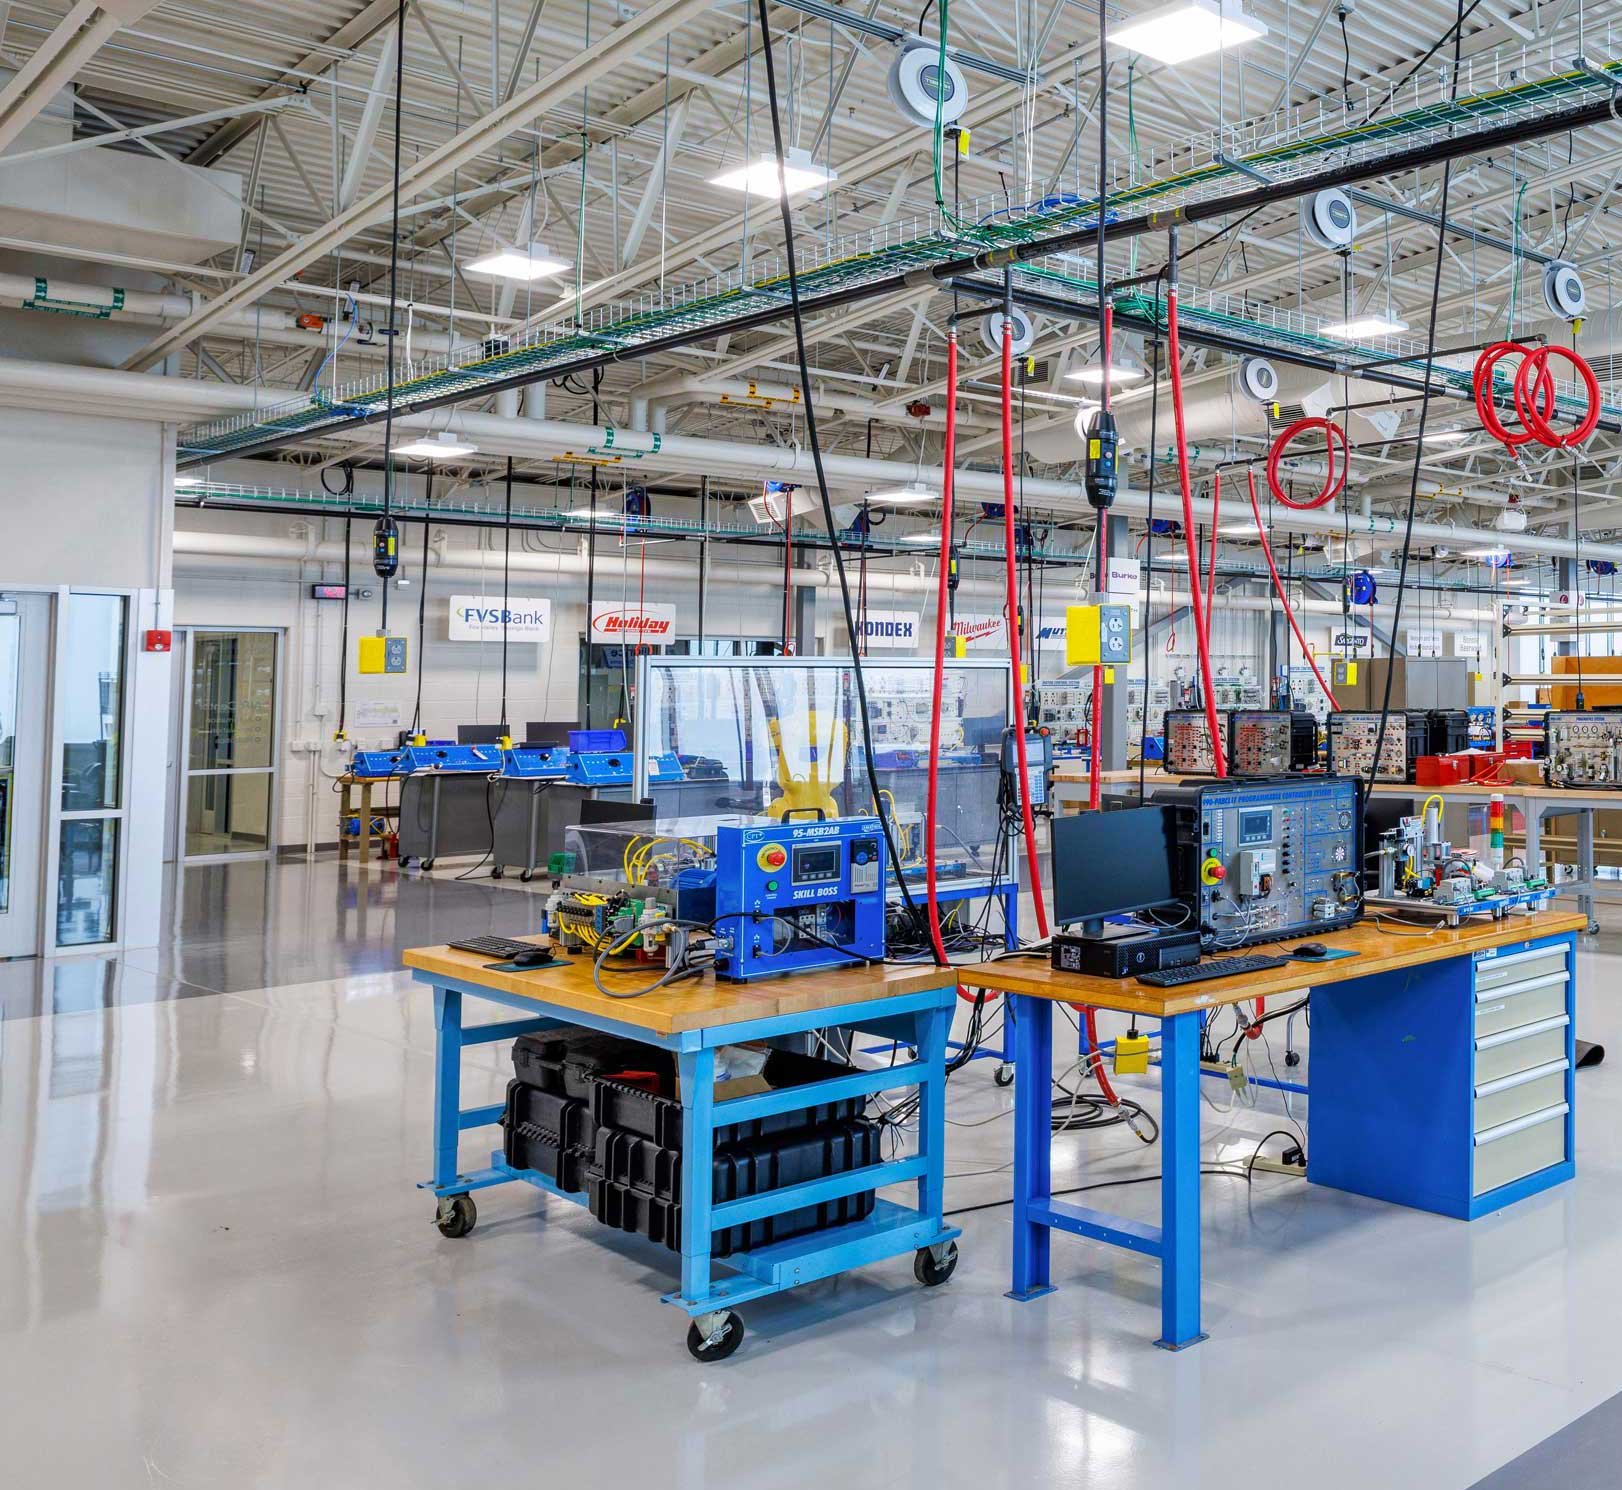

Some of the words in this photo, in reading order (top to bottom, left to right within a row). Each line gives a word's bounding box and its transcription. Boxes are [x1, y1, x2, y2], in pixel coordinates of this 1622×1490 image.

[464, 607, 544, 625] FVSBank
[605, 615, 670, 633] Holiday
[855, 621, 913, 637] KONDEX
[953, 618, 1002, 636] Milwaukee
[1035, 627, 1067, 639] MUT
[792, 826, 840, 838] 95-MSB2AB
[792, 888, 816, 900] SKILL
[817, 886, 838, 897] BOSS
